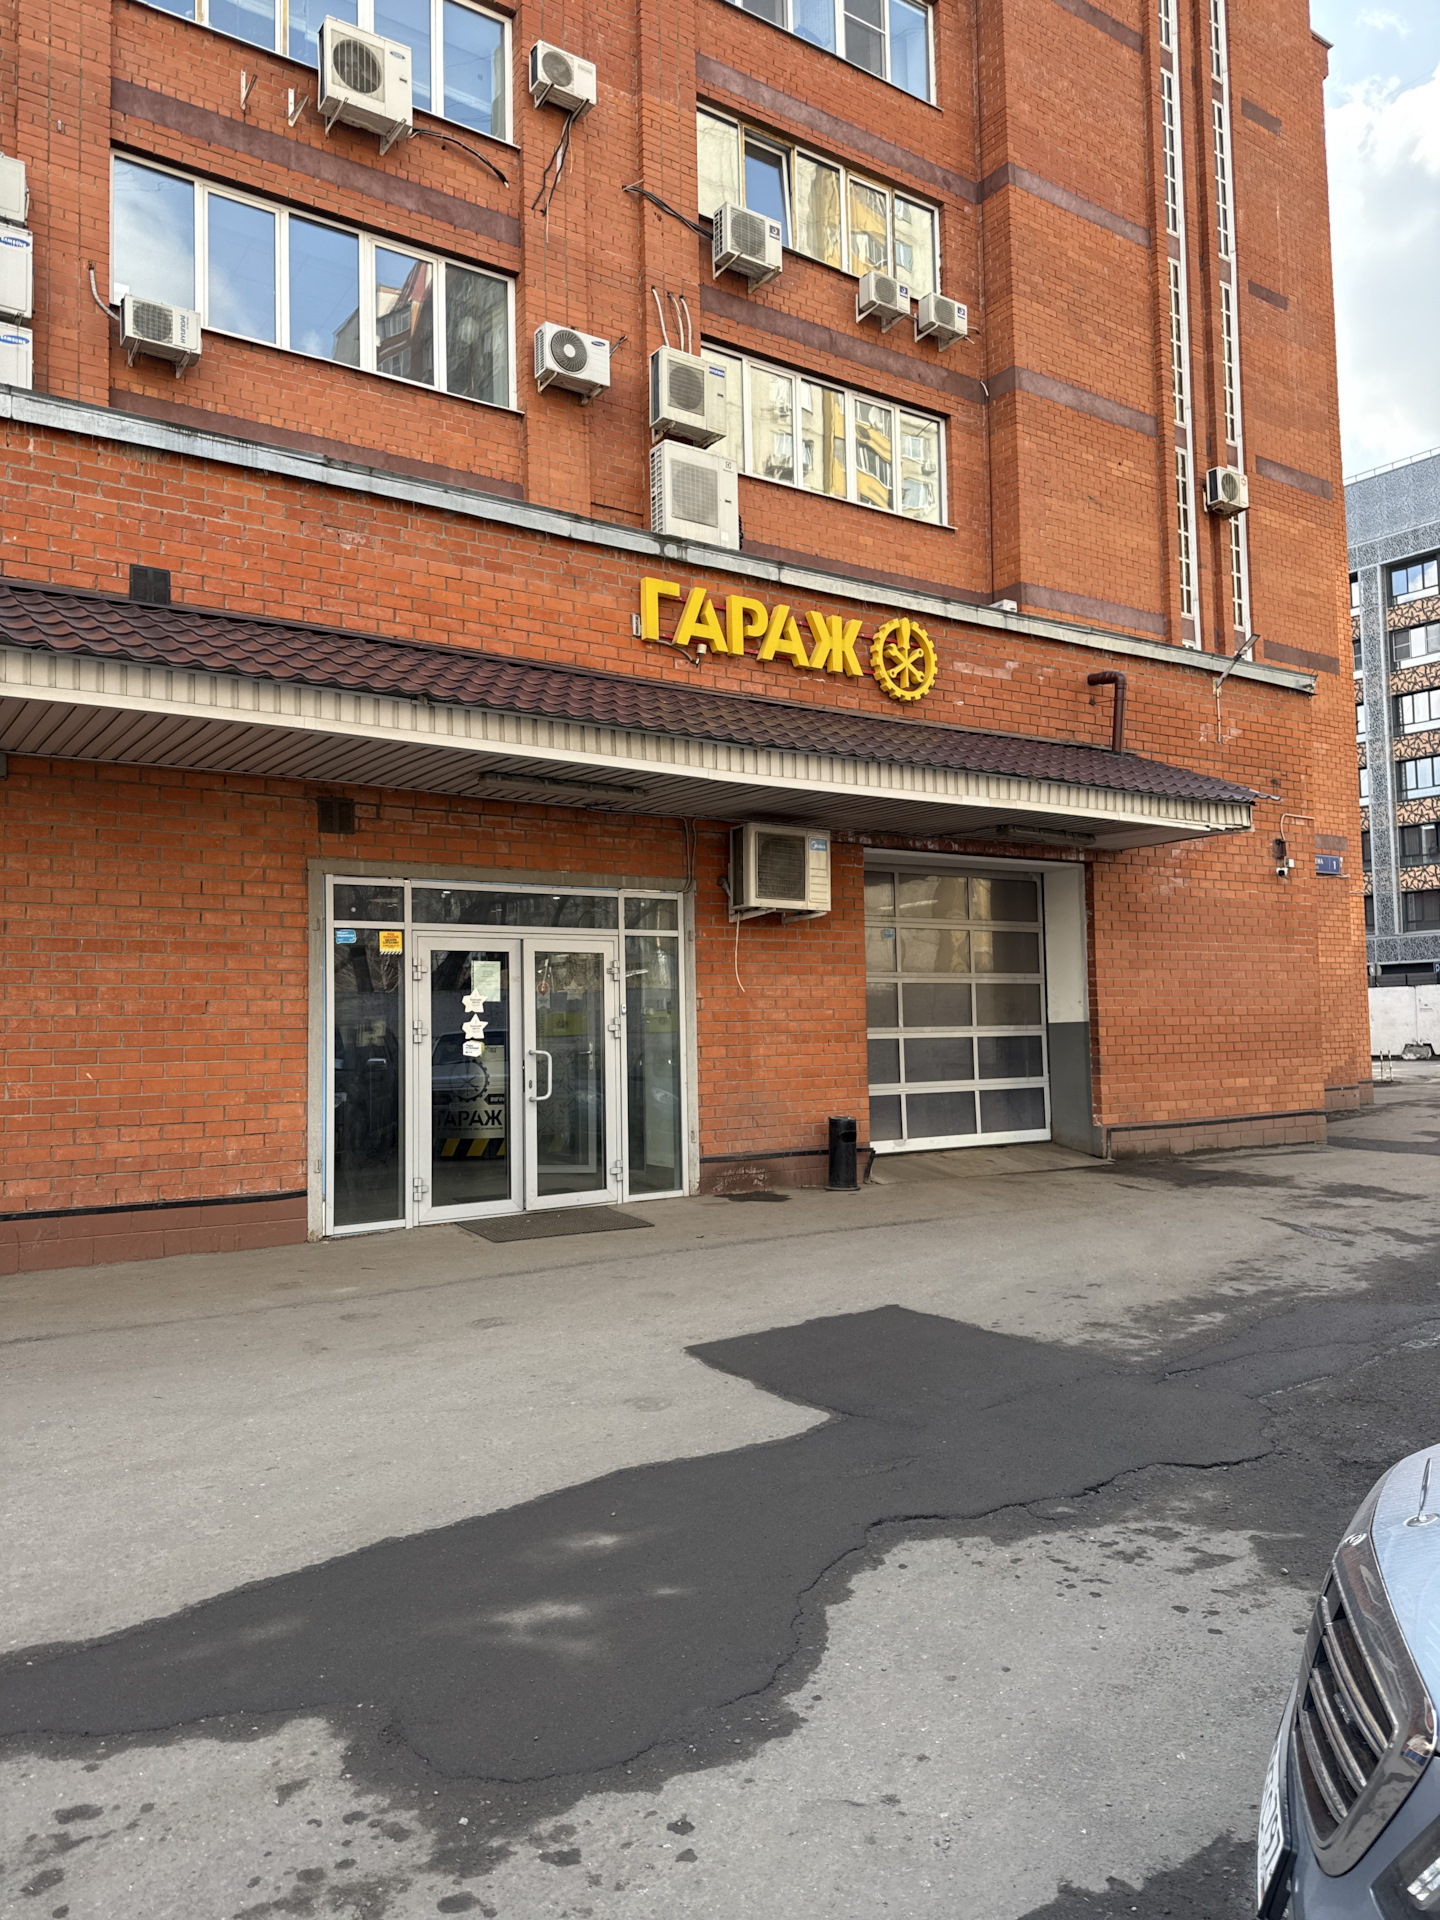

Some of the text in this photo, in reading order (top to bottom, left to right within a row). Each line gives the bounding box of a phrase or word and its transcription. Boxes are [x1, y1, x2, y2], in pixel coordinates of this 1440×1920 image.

[640, 577, 864, 677] ГАРАЖ
[1332, 860, 1337, 870] 1
[437, 1109, 503, 1127] ГАРАЖ
